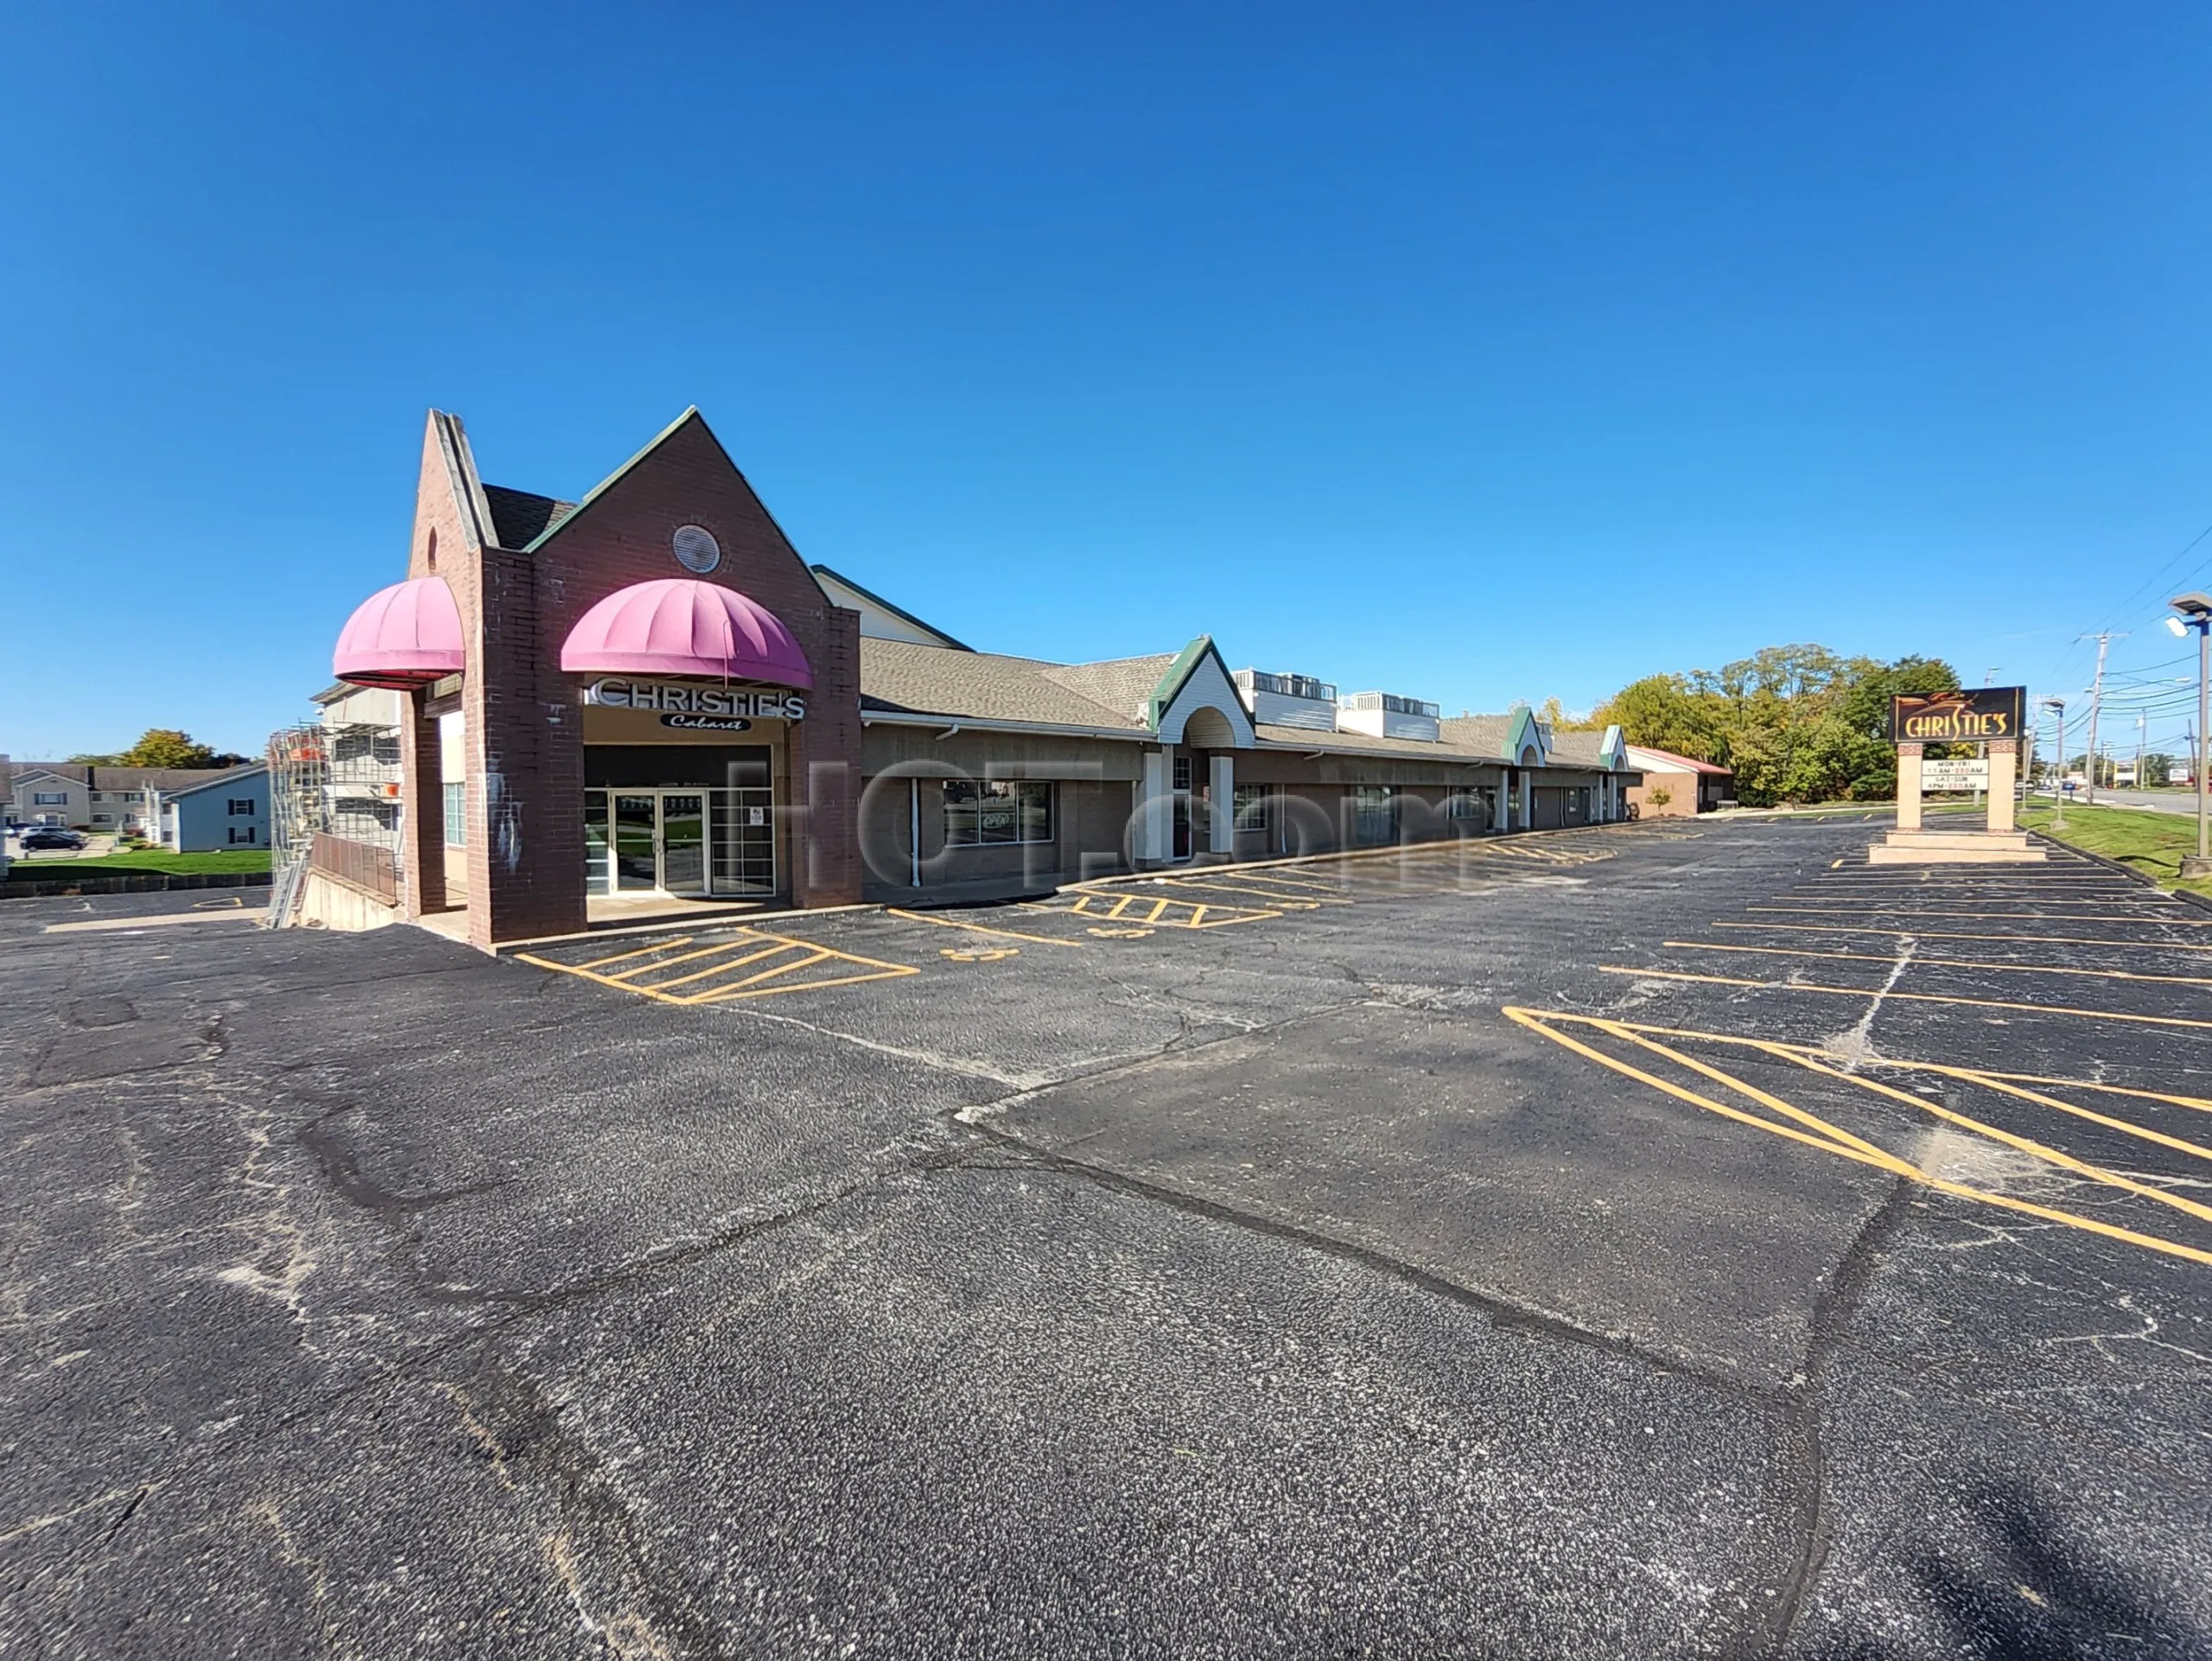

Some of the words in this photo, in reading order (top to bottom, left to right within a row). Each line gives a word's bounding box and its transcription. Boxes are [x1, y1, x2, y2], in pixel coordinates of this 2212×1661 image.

[595, 678, 806, 719] CHRISTIE'S
[670, 715, 743, 730] Cabaret
[1905, 703, 2007, 741] CHRISTIE'S
[985, 814, 1007, 826] OPEN
